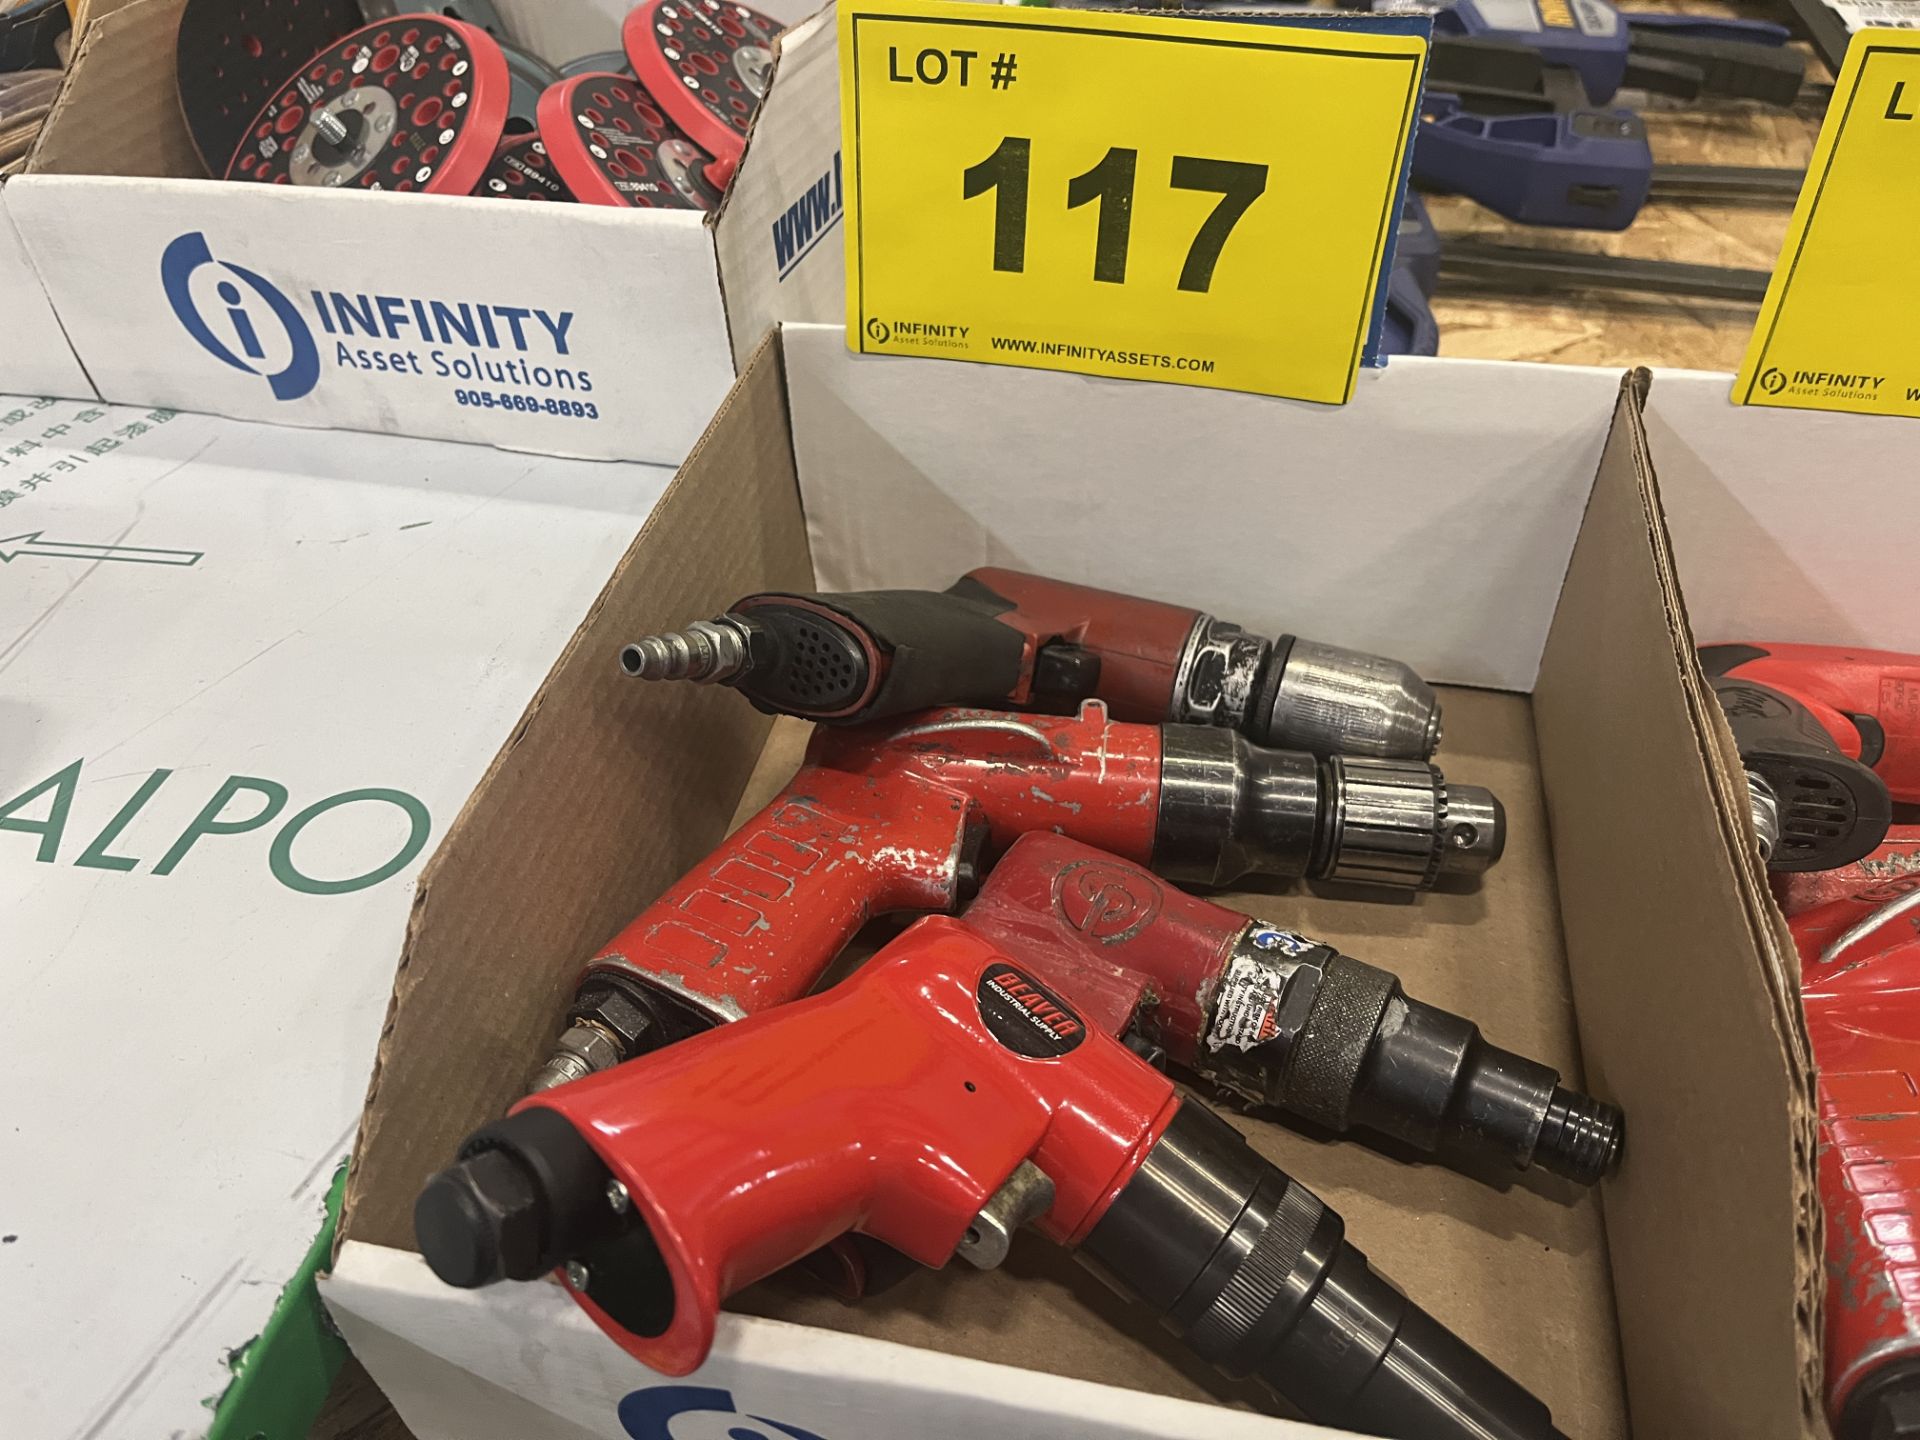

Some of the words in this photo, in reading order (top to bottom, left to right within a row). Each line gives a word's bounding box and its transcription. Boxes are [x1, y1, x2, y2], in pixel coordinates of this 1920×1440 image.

[888, 46, 978, 87] LOT
[990, 52, 1018, 90] #
[962, 136, 1269, 294] 117
[310, 290, 574, 356] INFINITY
[892, 336, 920, 346] Asset
[921, 337, 970, 350] Solutions
[893, 321, 970, 339] INFINITY
[336, 341, 423, 375] Asset
[431, 351, 594, 392] Solutions
[990, 337, 1216, 374] WWW.INFINITYASSETS.COM
[1787, 386, 1819, 397] Asset
[1822, 387, 1879, 401] Solutions
[1792, 371, 1886, 389] INFINITY
[454, 389, 601, 420] 905-669-8893
[0, 757, 432, 896] ALPO
[985, 979, 1032, 1018] INDUSTRIAL
[1030, 1015, 1062, 1041] SUPPLY
[992, 972, 1079, 1036] BEAVER
